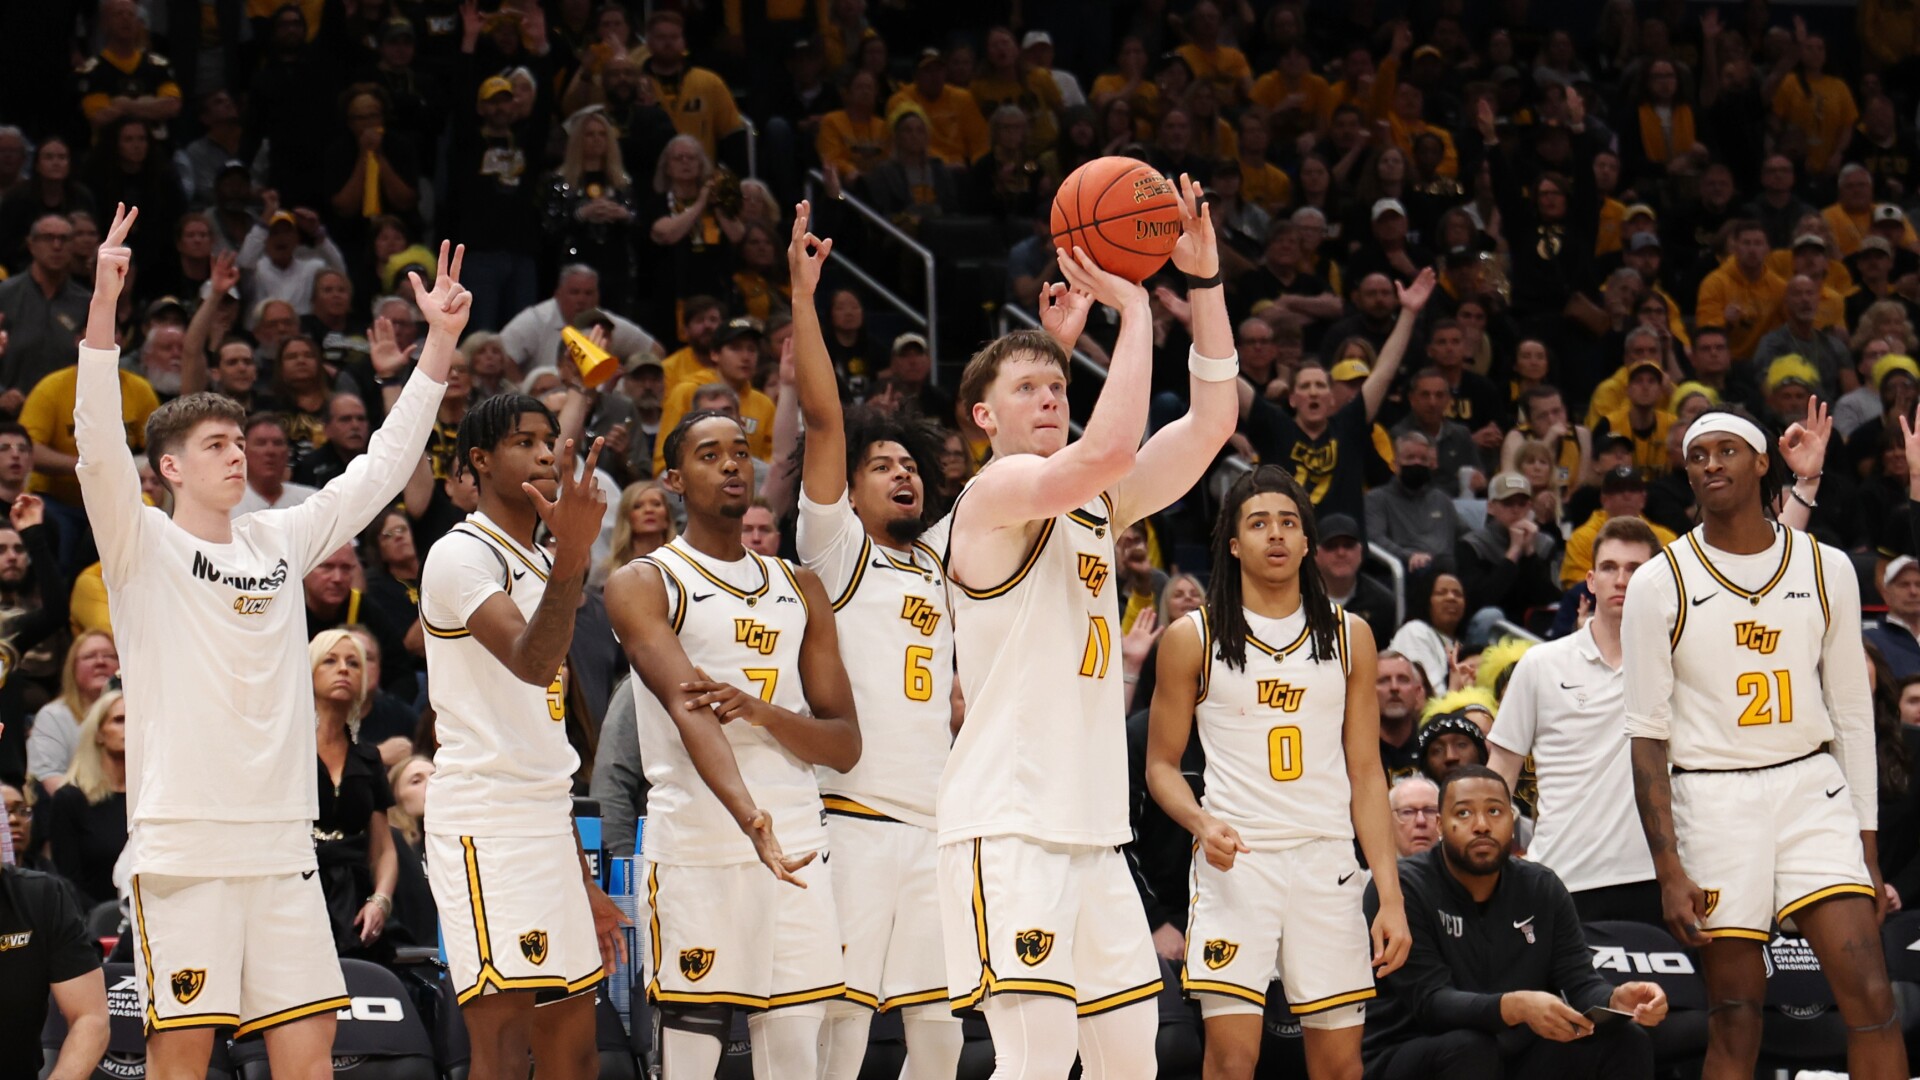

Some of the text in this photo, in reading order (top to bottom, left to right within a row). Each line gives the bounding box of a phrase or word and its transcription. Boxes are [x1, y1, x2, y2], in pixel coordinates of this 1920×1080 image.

[567, 340, 587, 365] VCU
[1443, 398, 1472, 419] CU
[236, 596, 273, 614] VCU
[901, 595, 942, 637] VCU
[734, 618, 780, 655] VCU
[1734, 620, 1781, 654] VCU
[742, 667, 779, 705] 7
[904, 644, 933, 702] 6
[1257, 679, 1306, 713] VCU
[1736, 669, 1793, 727] 21
[1268, 725, 1303, 782] 0
[1438, 909, 1463, 938] VCU
[9, 931, 33, 949] VCU
[1771, 947, 1814, 956] MEN'S BAS
[1586, 945, 1695, 974] A10
[107, 991, 138, 1001] MEN'S
[108, 1008, 142, 1018] WASHI
[103, 1059, 146, 1076] WIZAR
